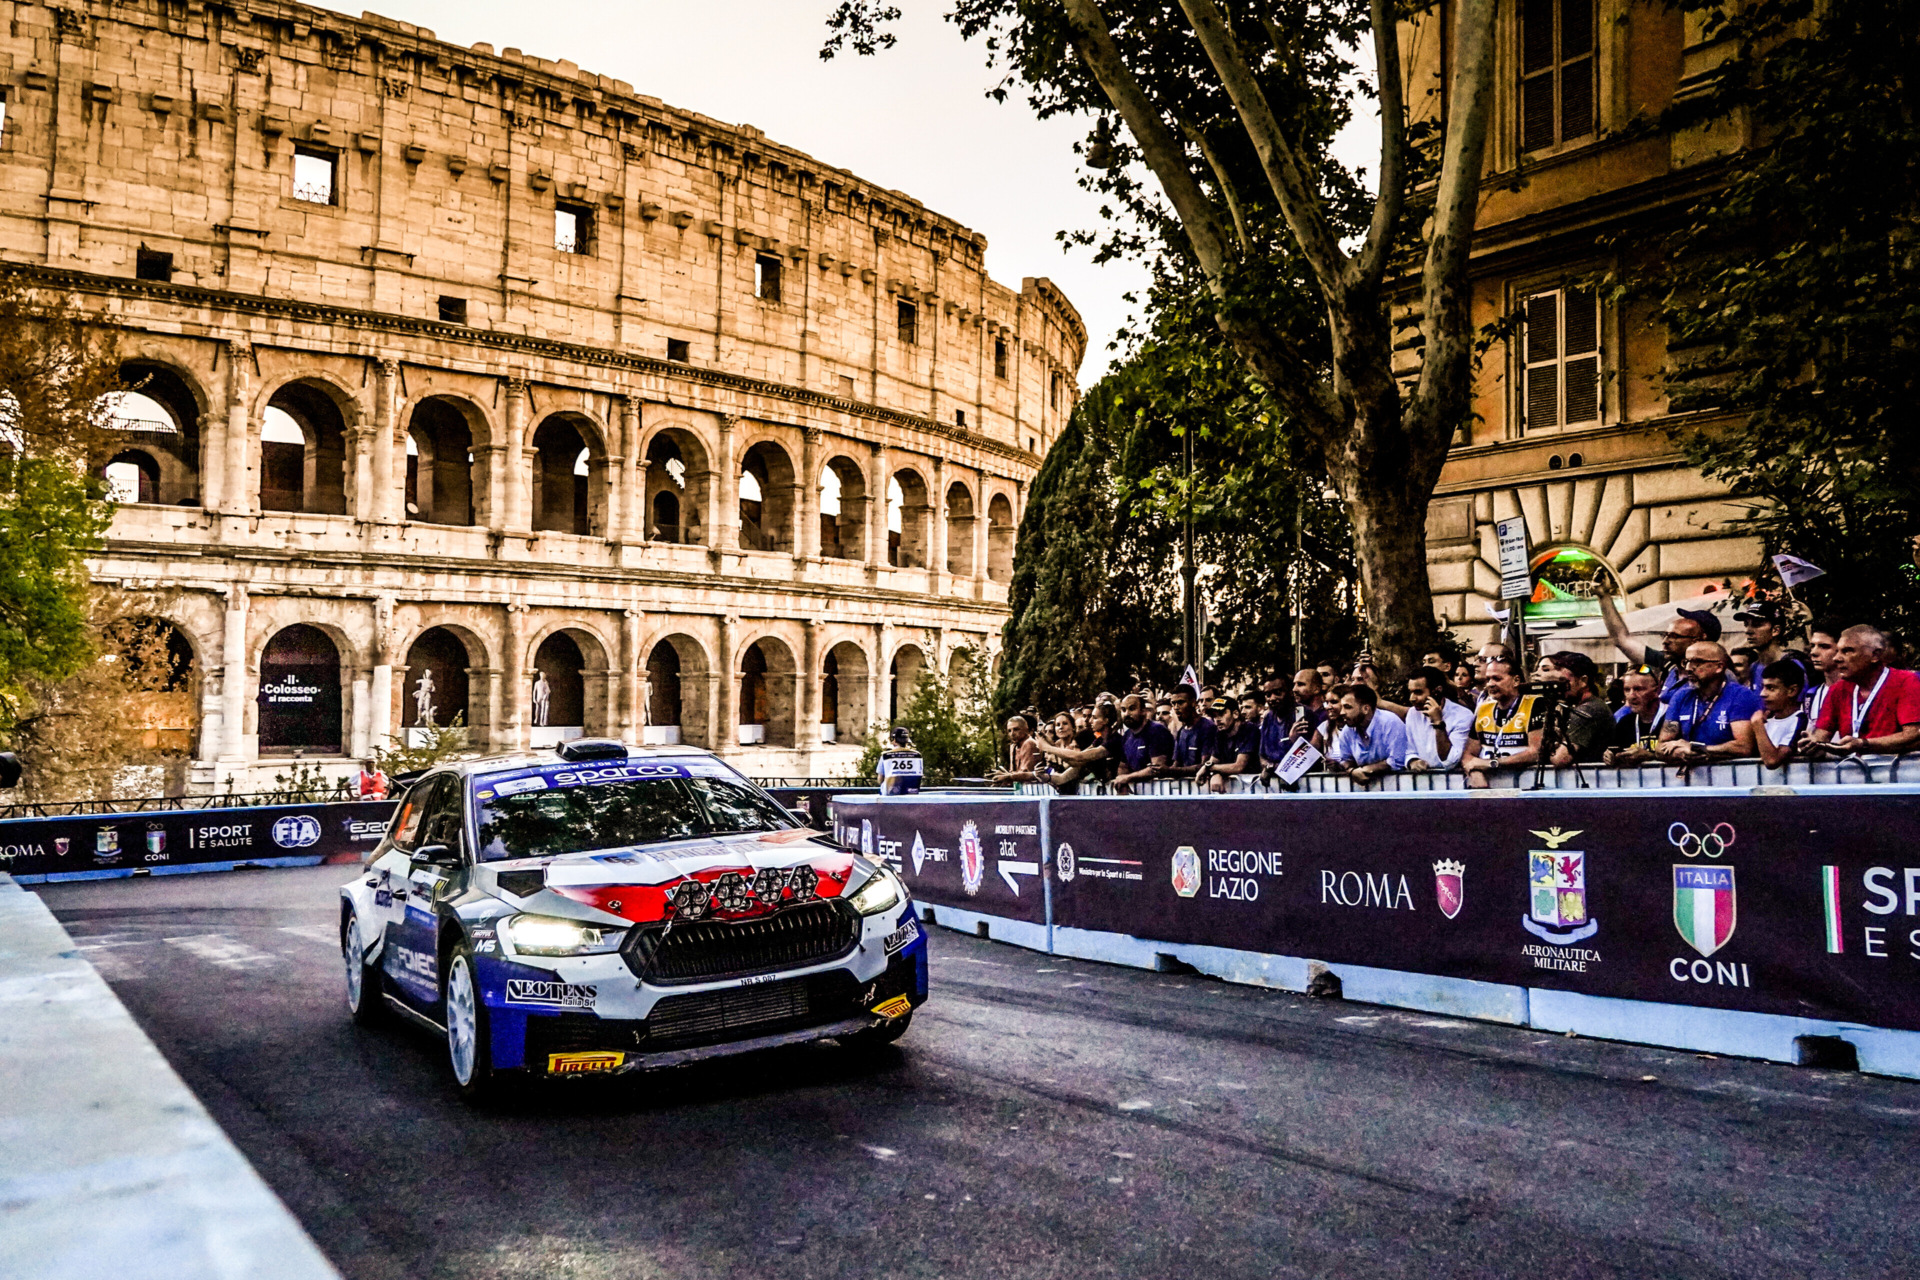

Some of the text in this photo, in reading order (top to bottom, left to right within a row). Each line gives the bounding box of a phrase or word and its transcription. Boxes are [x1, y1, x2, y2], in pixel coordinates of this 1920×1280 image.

[264, 684, 317, 694] Colosseo
[540, 764, 579, 772] FOLLOW
[891, 760, 914, 770] 265
[554, 765, 679, 785] sparco
[199, 824, 252, 839] SPORT
[1016, 825, 1037, 836] PARTNER
[199, 837, 252, 849] E SALUTE
[999, 839, 1017, 857] atac
[145, 853, 169, 862] CONI
[1208, 849, 1283, 875] REGIONE
[1680, 871, 1729, 885] ITALIA
[1209, 876, 1259, 901] LAZIO
[1320, 869, 1416, 911] ROMA
[1864, 926, 1888, 957] E
[1521, 944, 1601, 962] AERONAUTICA
[1534, 956, 1586, 972] MILITARE
[1669, 957, 1750, 988] CONI
[506, 979, 597, 1003] NEOTENS
[563, 997, 596, 1007] Italia Srl
[554, 1056, 617, 1072] PIRELLI
